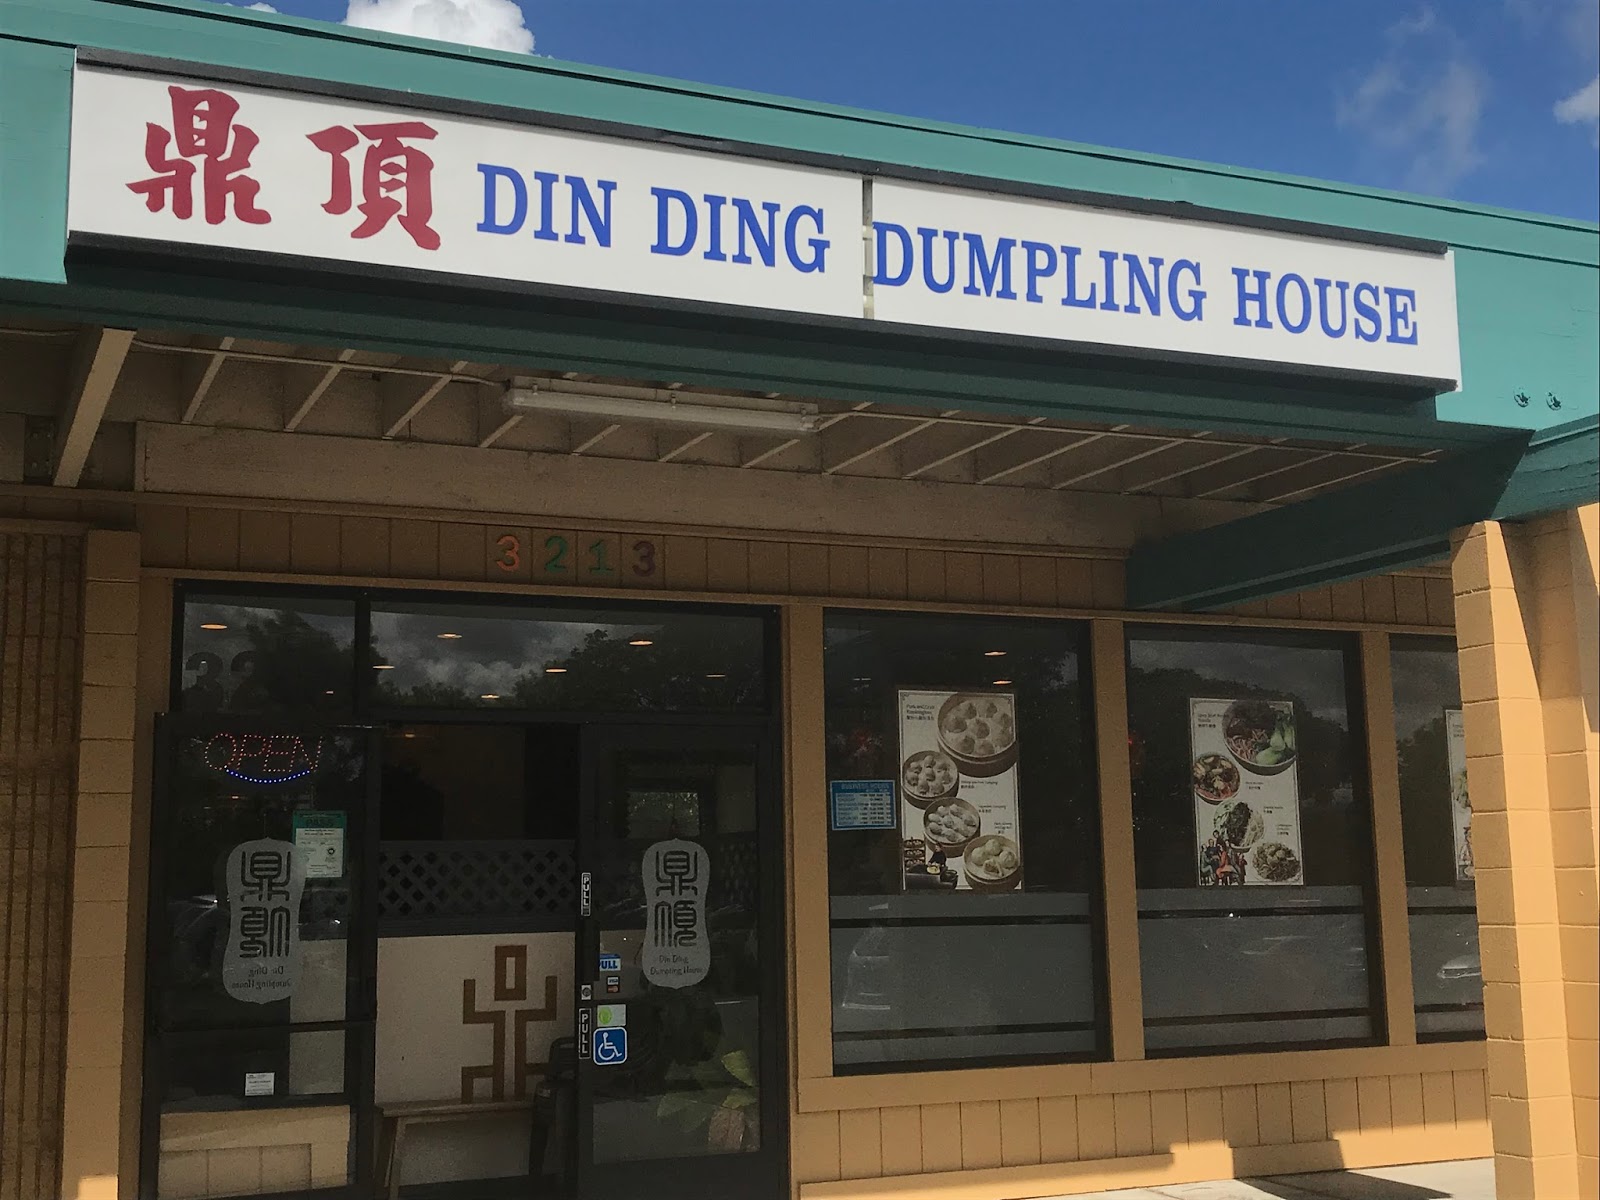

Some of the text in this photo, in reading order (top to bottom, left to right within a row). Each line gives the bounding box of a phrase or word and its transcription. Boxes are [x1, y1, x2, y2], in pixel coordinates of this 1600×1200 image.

[126, 86, 441, 250] 鼎頂
[477, 163, 1418, 346] DIN DING DUMPLING HOUSE
[495, 533, 656, 577] 3213
[203, 731, 323, 773] OPEN
[599, 960, 618, 970] ULL
[581, 1013, 589, 1054] PULL
